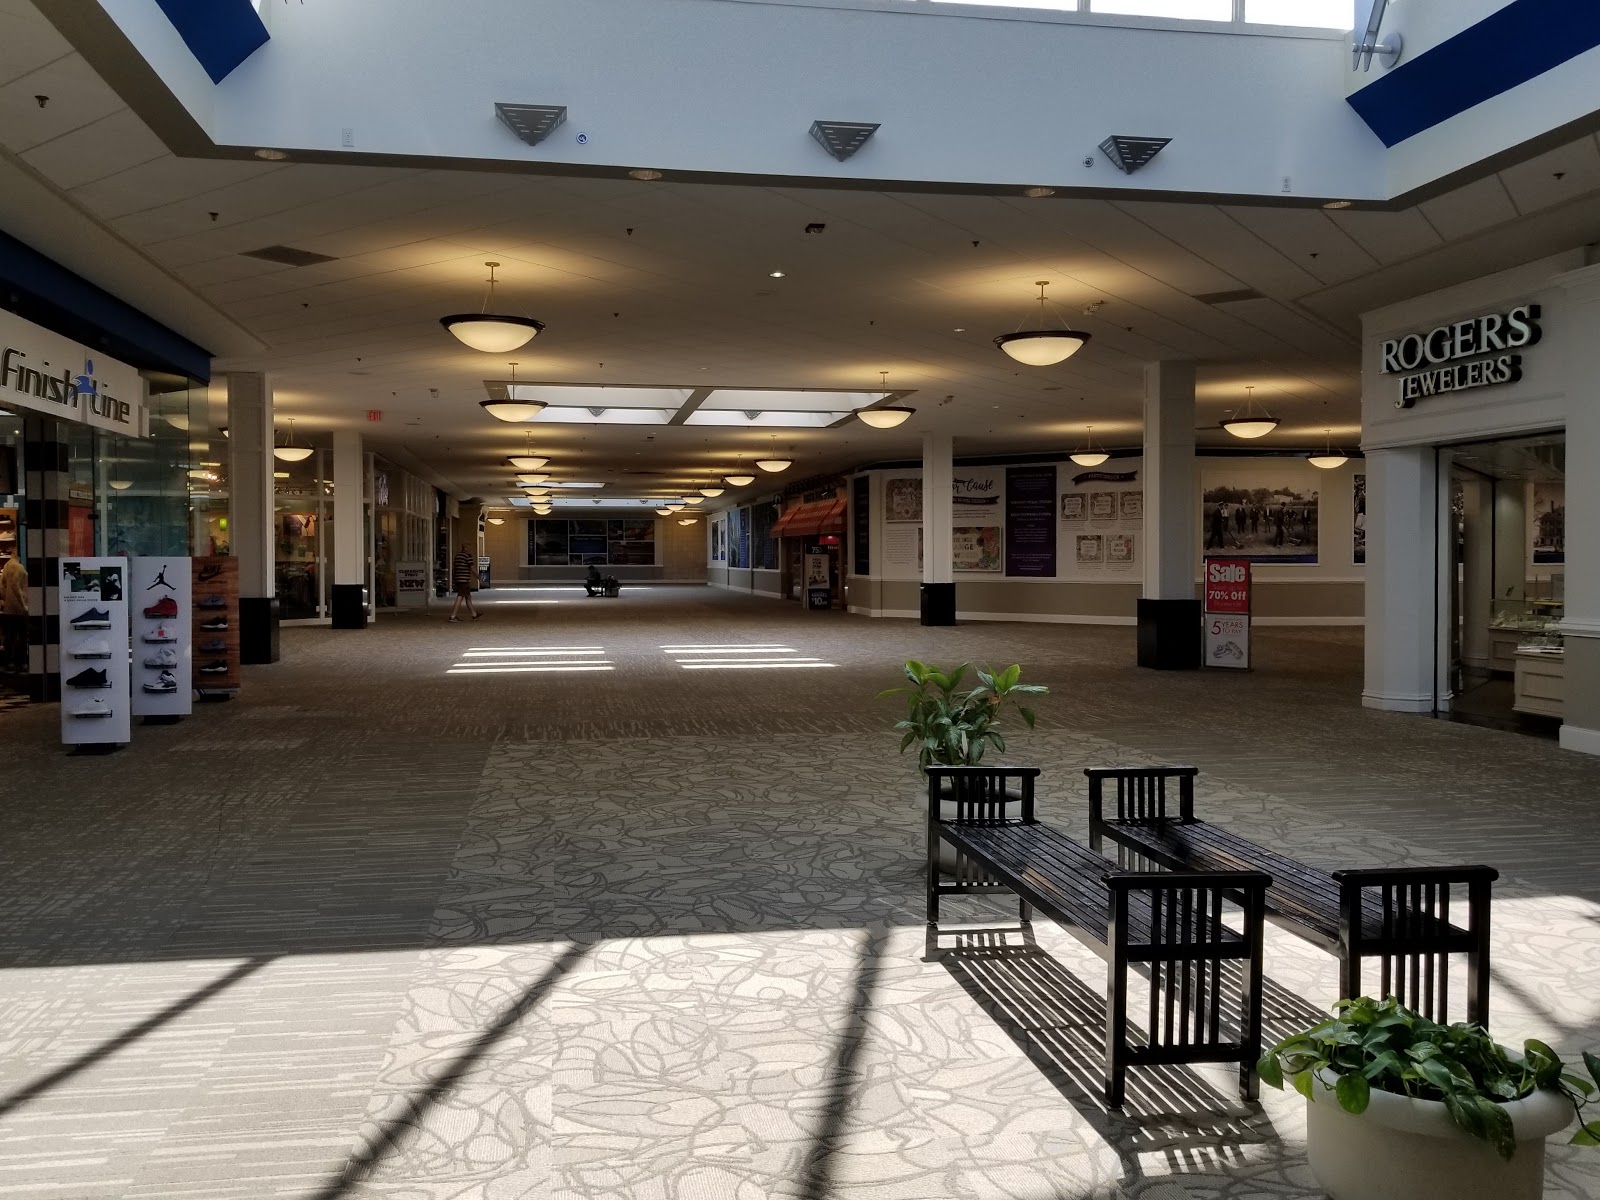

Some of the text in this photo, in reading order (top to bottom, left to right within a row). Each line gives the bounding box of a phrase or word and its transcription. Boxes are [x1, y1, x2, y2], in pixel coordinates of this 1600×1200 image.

[1379, 305, 1538, 375] ROGERS
[1394, 355, 1517, 409] JEWELERS
[367, 410, 383, 422] EXIT
[966, 478, 993, 492] Cause
[1209, 563, 1246, 583] Sale
[399, 579, 425, 588] NEW
[1209, 590, 1247, 601] 70% Off
[1211, 620, 1221, 635] 5
